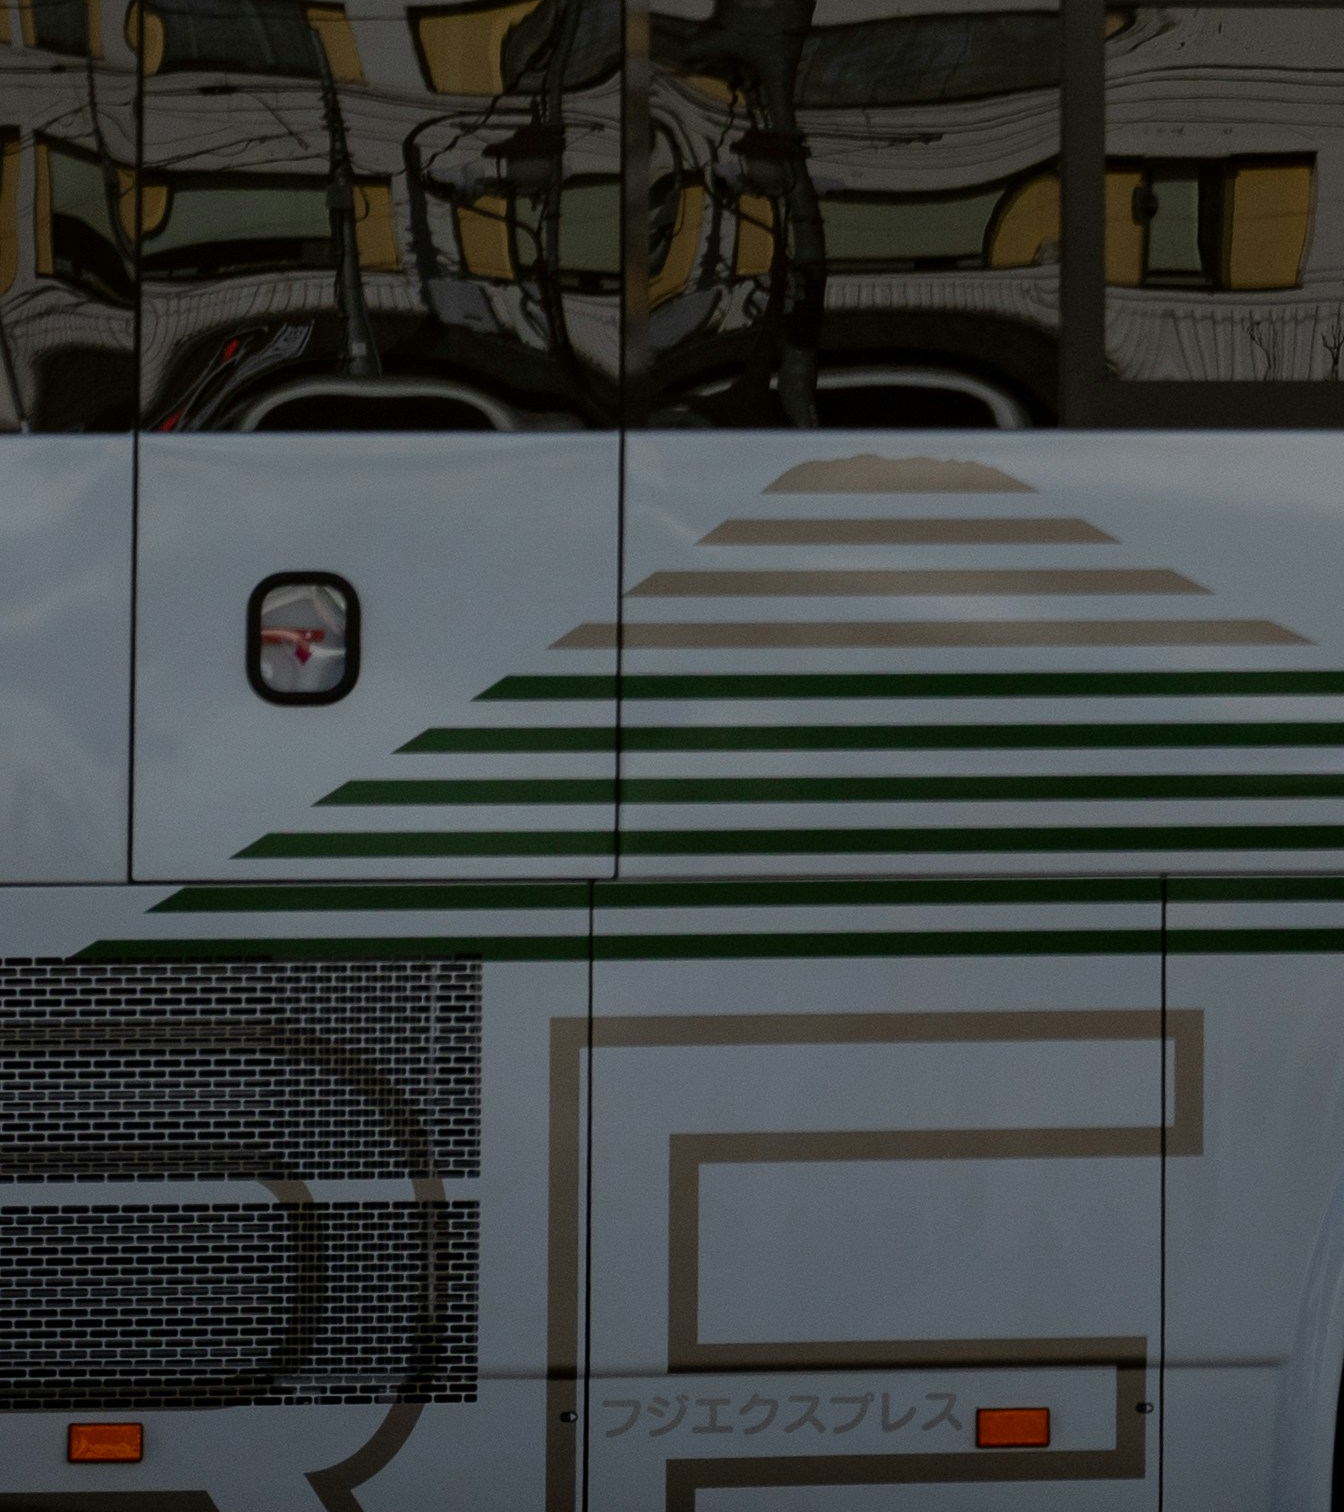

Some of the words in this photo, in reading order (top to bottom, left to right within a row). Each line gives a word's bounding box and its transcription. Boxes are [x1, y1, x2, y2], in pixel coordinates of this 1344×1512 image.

[601, 1391, 964, 1438] フジエクスプレス
